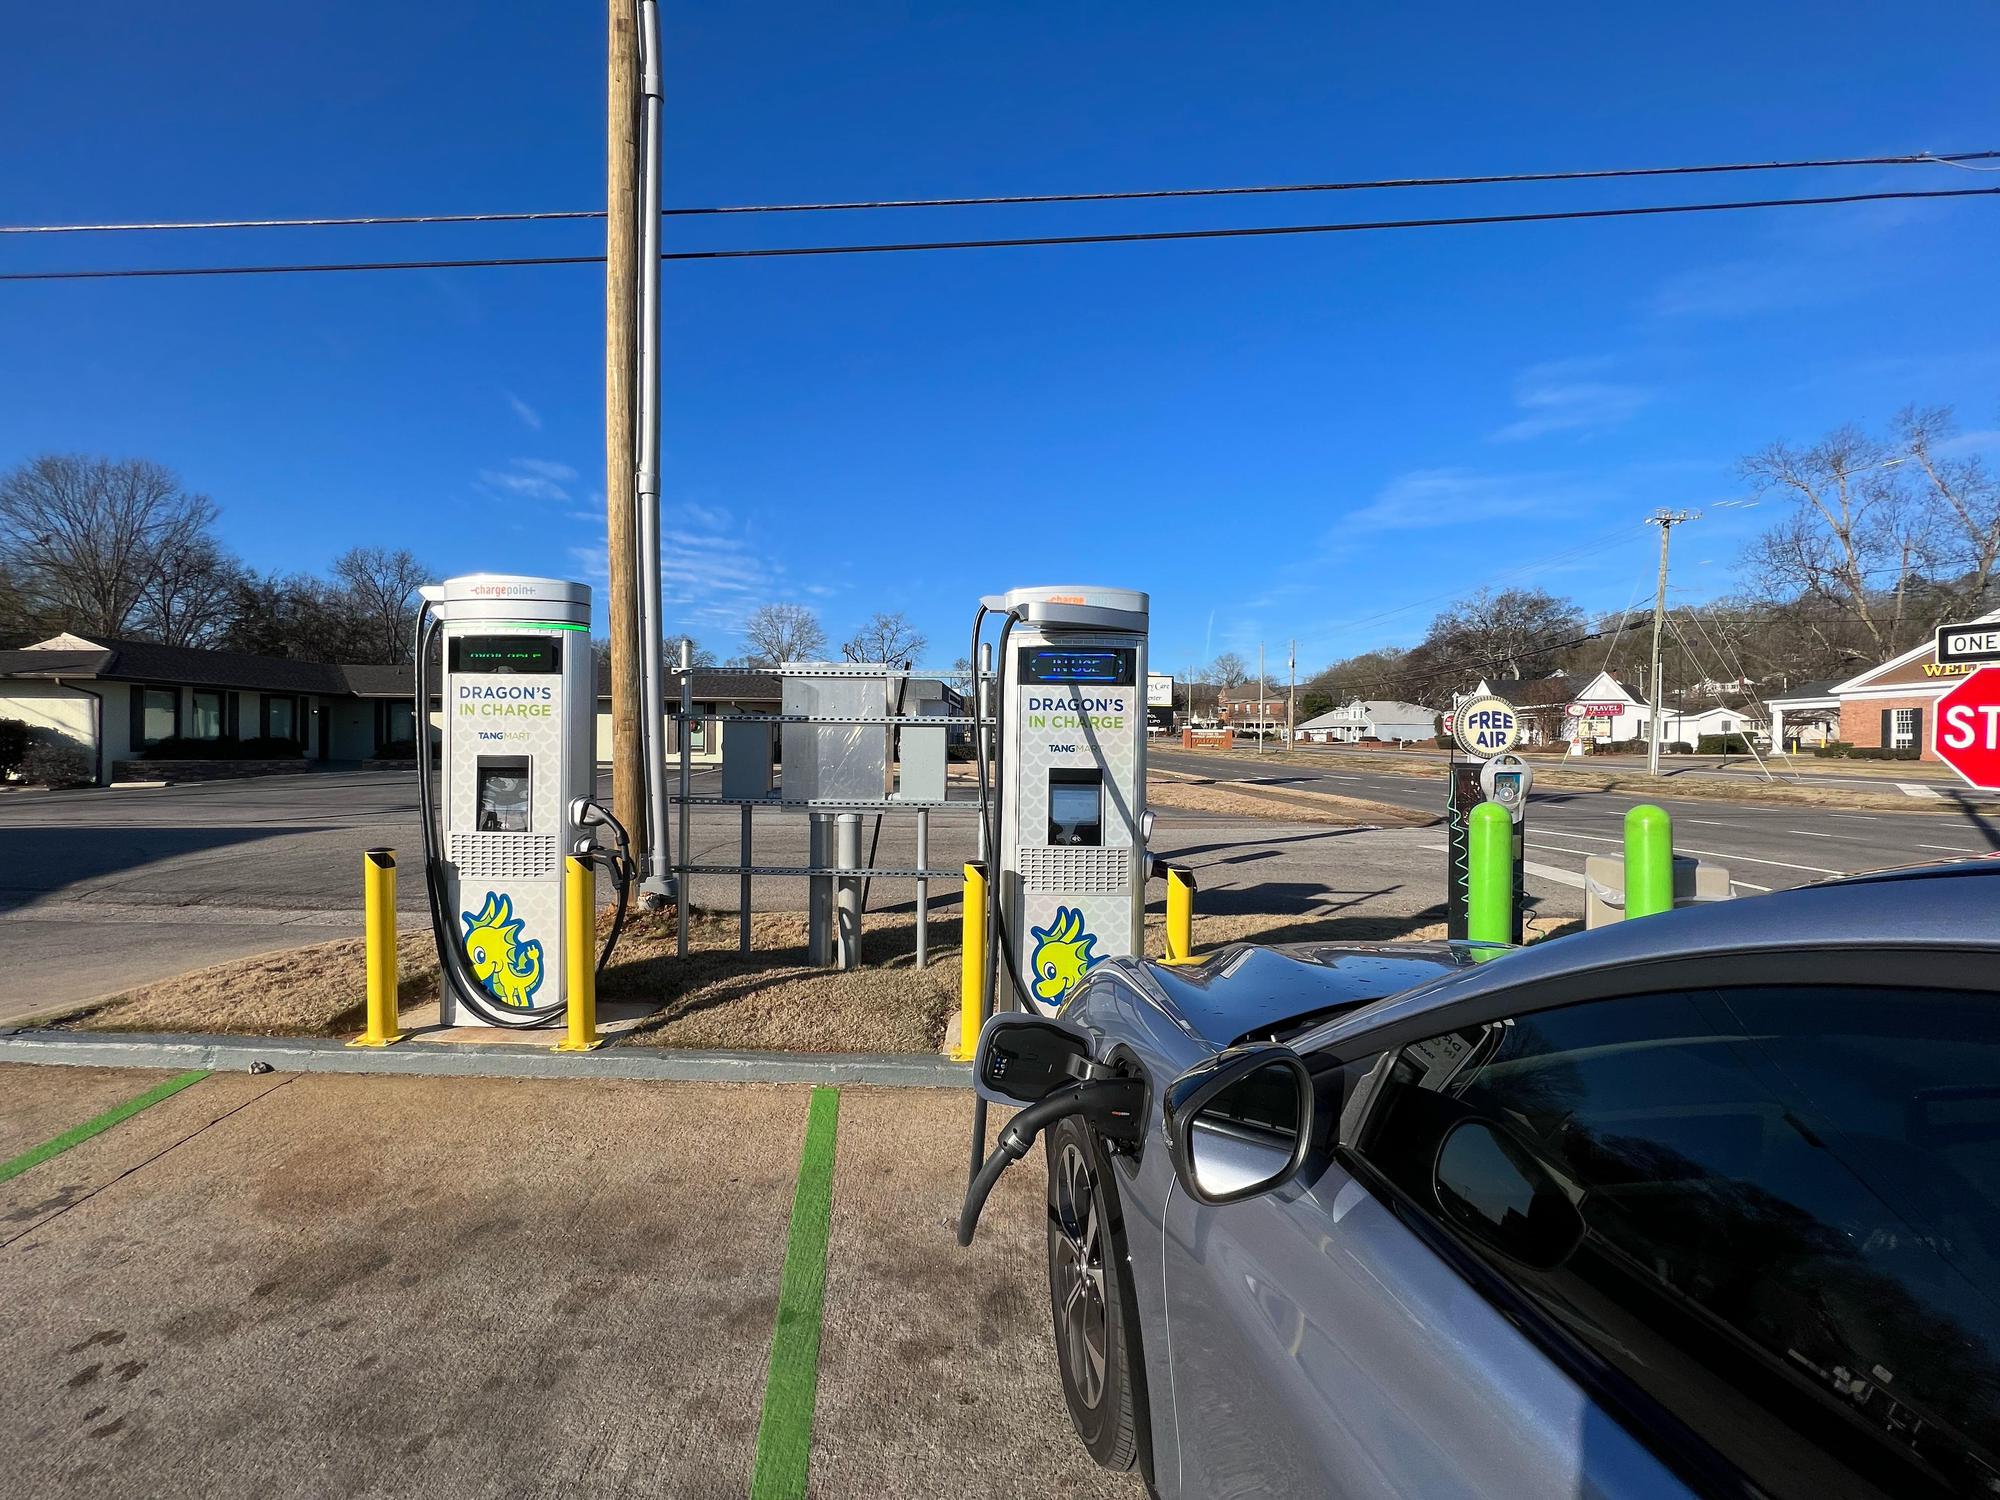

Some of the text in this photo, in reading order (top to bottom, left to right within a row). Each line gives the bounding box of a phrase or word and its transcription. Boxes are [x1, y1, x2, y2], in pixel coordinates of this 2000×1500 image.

[1954, 634, 1998, 652] ONE
[459, 686, 552, 700] DRAGON'S
[459, 703, 552, 719] IN CHARGE
[1028, 697, 1124, 712] DRAGON'S
[1028, 715, 1124, 731] IN CHARGE
[1468, 711, 1514, 729] FREE
[478, 731, 531, 741] TANGMART
[1476, 731, 1507, 748] AIR
